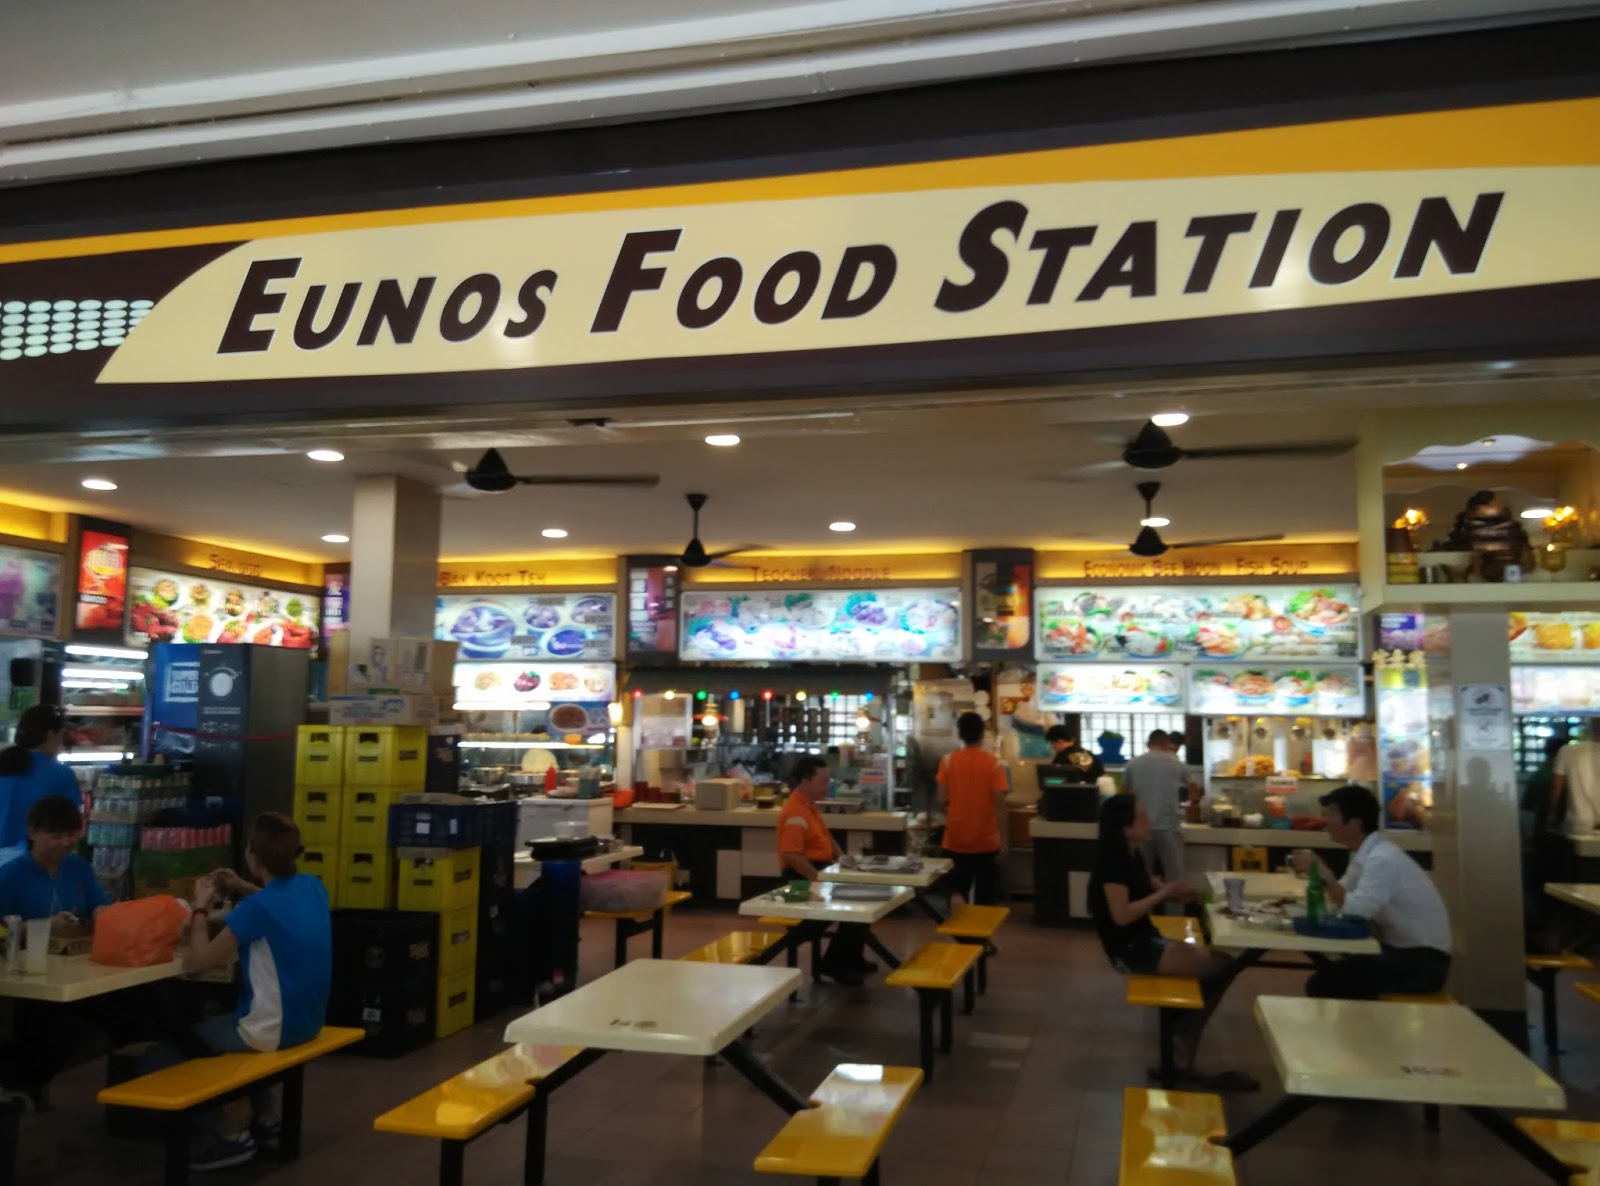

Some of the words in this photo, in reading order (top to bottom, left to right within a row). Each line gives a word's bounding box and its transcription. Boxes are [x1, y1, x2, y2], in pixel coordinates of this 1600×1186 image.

[217, 257, 558, 354] EUNOS
[590, 229, 897, 334] FOOD
[934, 192, 1505, 313] STATION
